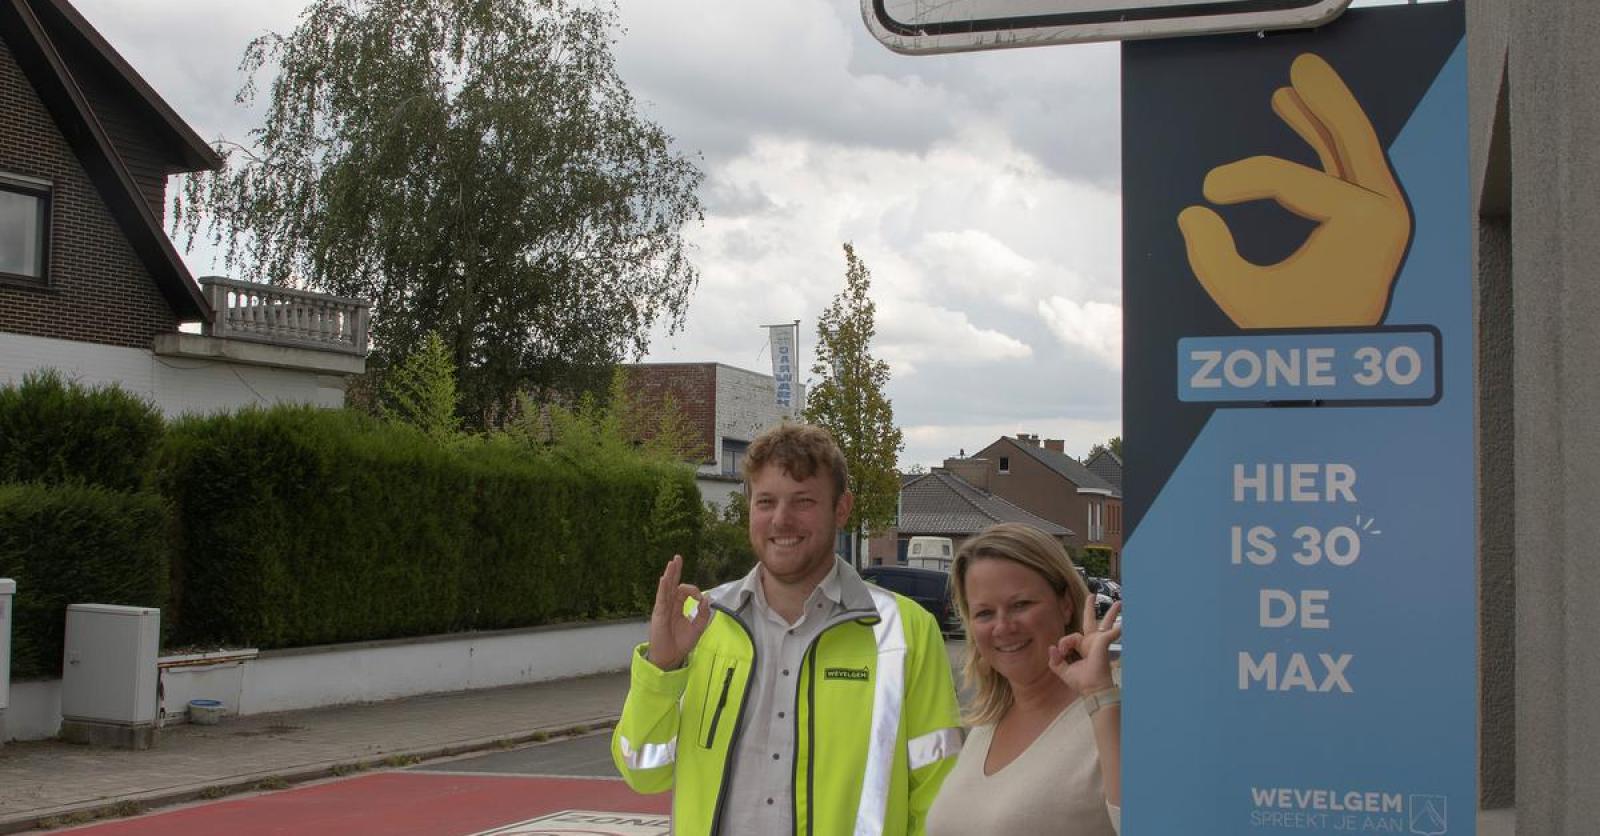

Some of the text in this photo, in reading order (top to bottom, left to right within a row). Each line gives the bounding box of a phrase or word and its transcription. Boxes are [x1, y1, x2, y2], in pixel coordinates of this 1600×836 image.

[1190, 346, 1422, 388] ZONE 30
[1233, 463, 1358, 502] HIER
[1231, 526, 1361, 566] IS 30
[1259, 589, 1330, 629] DE
[1238, 651, 1353, 693] MAX
[1251, 787, 1403, 813] WEVELGEM
[1250, 811, 1403, 832] SPREEKT JE AAN
